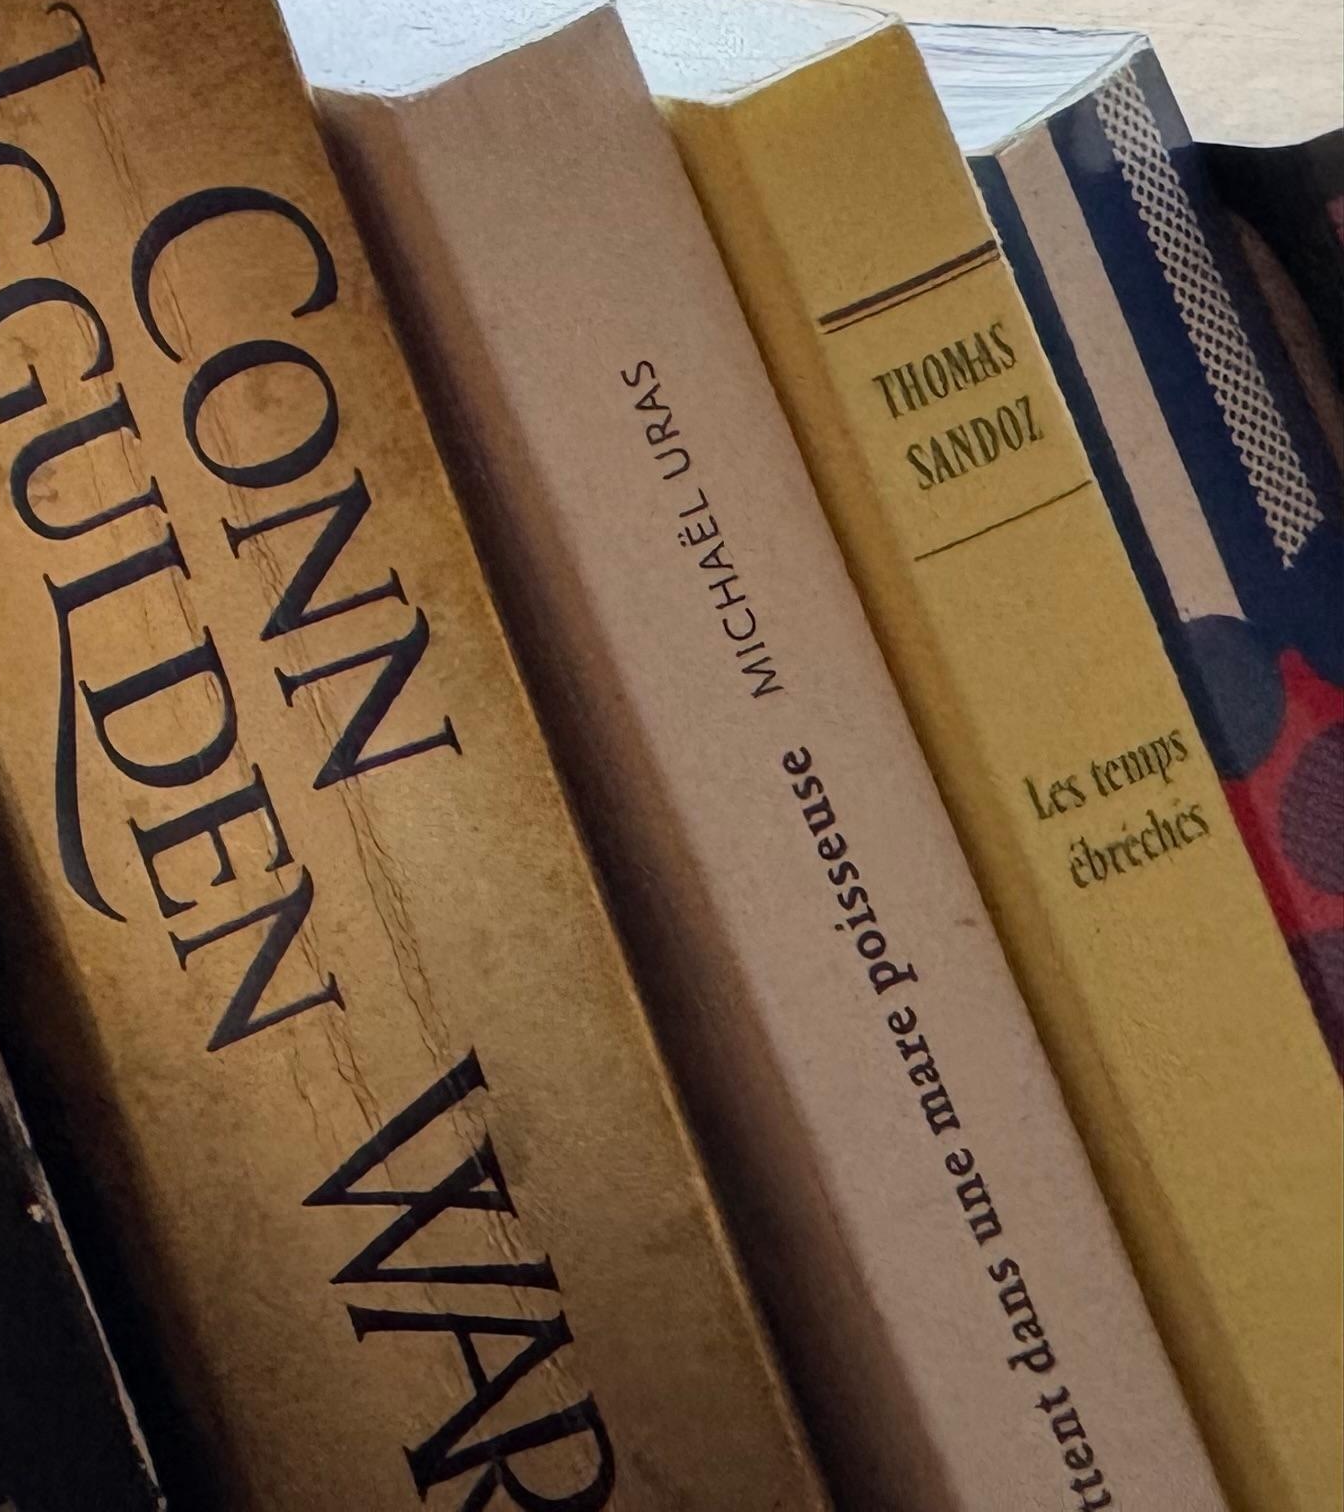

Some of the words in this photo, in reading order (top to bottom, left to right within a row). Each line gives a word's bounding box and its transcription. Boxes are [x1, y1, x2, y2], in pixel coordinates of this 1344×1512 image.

[620, 360, 691, 481] URAS
[872, 321, 1018, 421] THOMAS
[131, 186, 462, 790] CONN
[907, 396, 1045, 491] SANDOZ
[679, 488, 784, 699] MICHAËL
[1021, 773, 1087, 822] Les
[1089, 726, 1191, 797] temps
[782, 745, 918, 995] poisseuse
[1068, 798, 1214, 889] ébréchés
[888, 1005, 961, 1136] mare
[945, 1147, 1004, 1246] une
[302, 1046, 616, 1512] WAR
[988, 1257, 1056, 1374] dans
